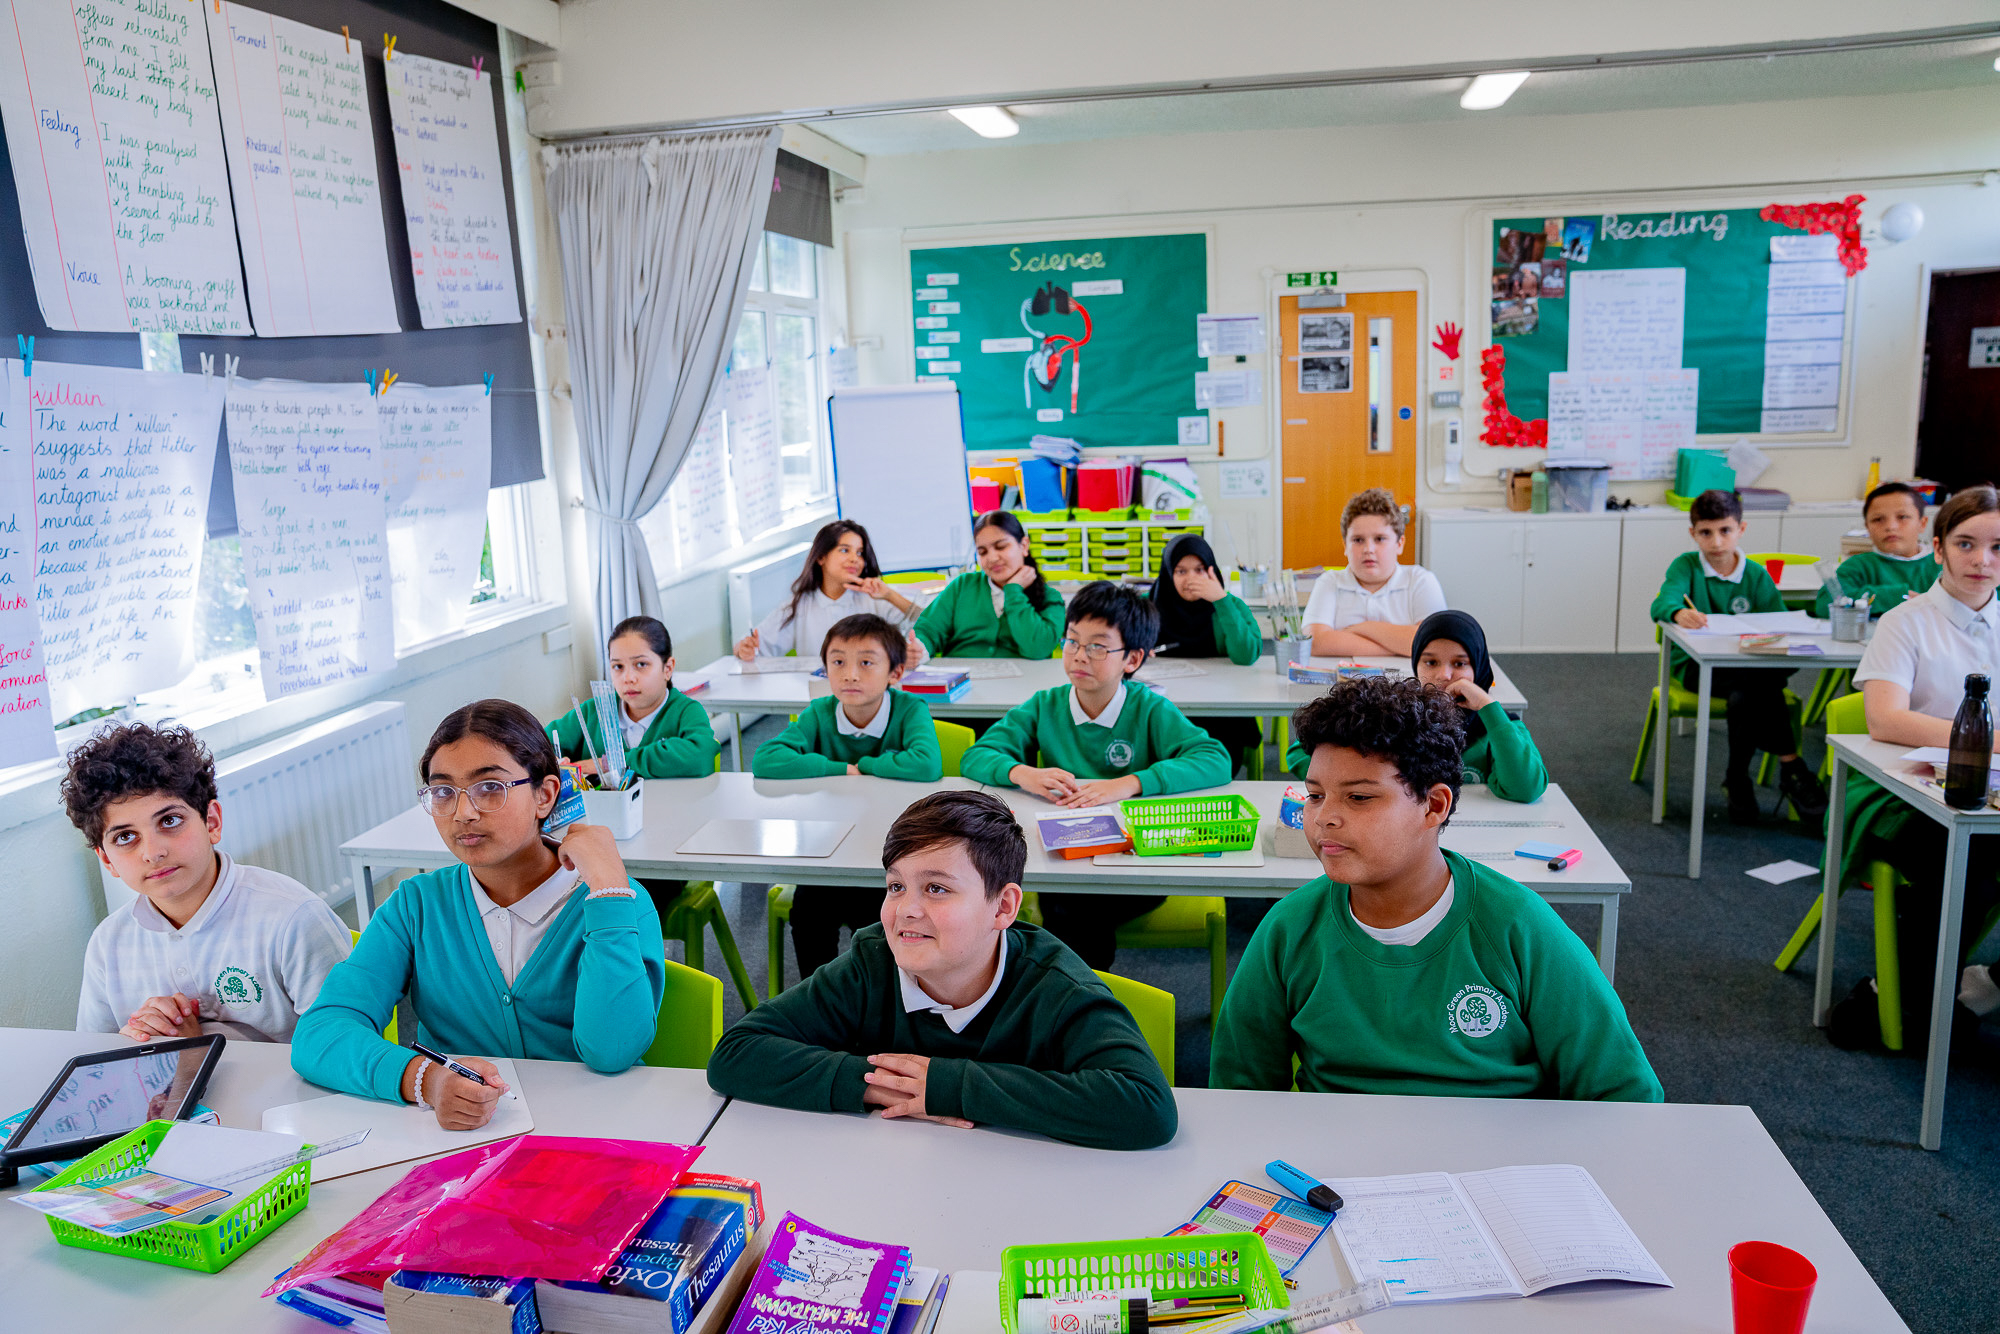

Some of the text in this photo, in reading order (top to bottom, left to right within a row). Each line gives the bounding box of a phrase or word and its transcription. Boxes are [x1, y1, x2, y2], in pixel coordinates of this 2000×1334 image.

[76, 4, 114, 31] officer
[81, 26, 114, 51] from
[150, 45, 160, 62] I
[275, 35, 294, 56] The
[84, 56, 106, 82] my
[112, 56, 139, 80] last
[136, 93, 159, 119] my
[168, 97, 193, 127] body
[41, 109, 81, 148] Feeling
[100, 121, 197, 166] I was paralysed
[104, 150, 133, 169] with
[108, 171, 219, 215] My trembling legs
[120, 200, 160, 220] seemed
[168, 205, 200, 232] glued
[1601, 211, 1729, 241] Reading
[116, 221, 133, 241] the
[66, 260, 101, 285] Voice
[1010, 247, 1106, 272] Science
[126, 264, 135, 287] A
[126, 293, 230, 313] voice beckoned me
[33, 383, 106, 407] villain
[34, 408, 67, 431] The
[77, 412, 119, 432] word
[33, 434, 198, 465] suggests that Hitler
[36, 458, 160, 480] was a malicious
[37, 482, 194, 514] antagonist who was a
[40, 513, 95, 530] menace
[100, 507, 112, 526] to
[164, 499, 174, 517] It
[183, 508, 196, 518] is
[38, 540, 60, 554] an
[68, 528, 110, 552] emotive
[113, 527, 136, 547] word
[151, 527, 176, 539] use
[36, 543, 189, 578] because the author wants
[36, 583, 54, 602] the
[62, 576, 97, 598] reader
[119, 562, 194, 586] understand
[78, 599, 99, 618] did
[105, 585, 147, 608] terrible
[152, 604, 176, 621] An
[128, 626, 148, 643] be
[0, 667, 47, 690] ominal
[226, 966, 250, 977] Primary
[1447, 983, 1509, 1034] Moor Green Primary Academy
[629, 1237, 693, 1258] Thesau
[621, 1252, 685, 1271] Paperb
[684, 1222, 745, 1309] Thesaurus
[604, 1265, 673, 1290] Oxfo
[751, 1292, 841, 1325] MELTDOWN
[841, 1308, 871, 1328] THE
